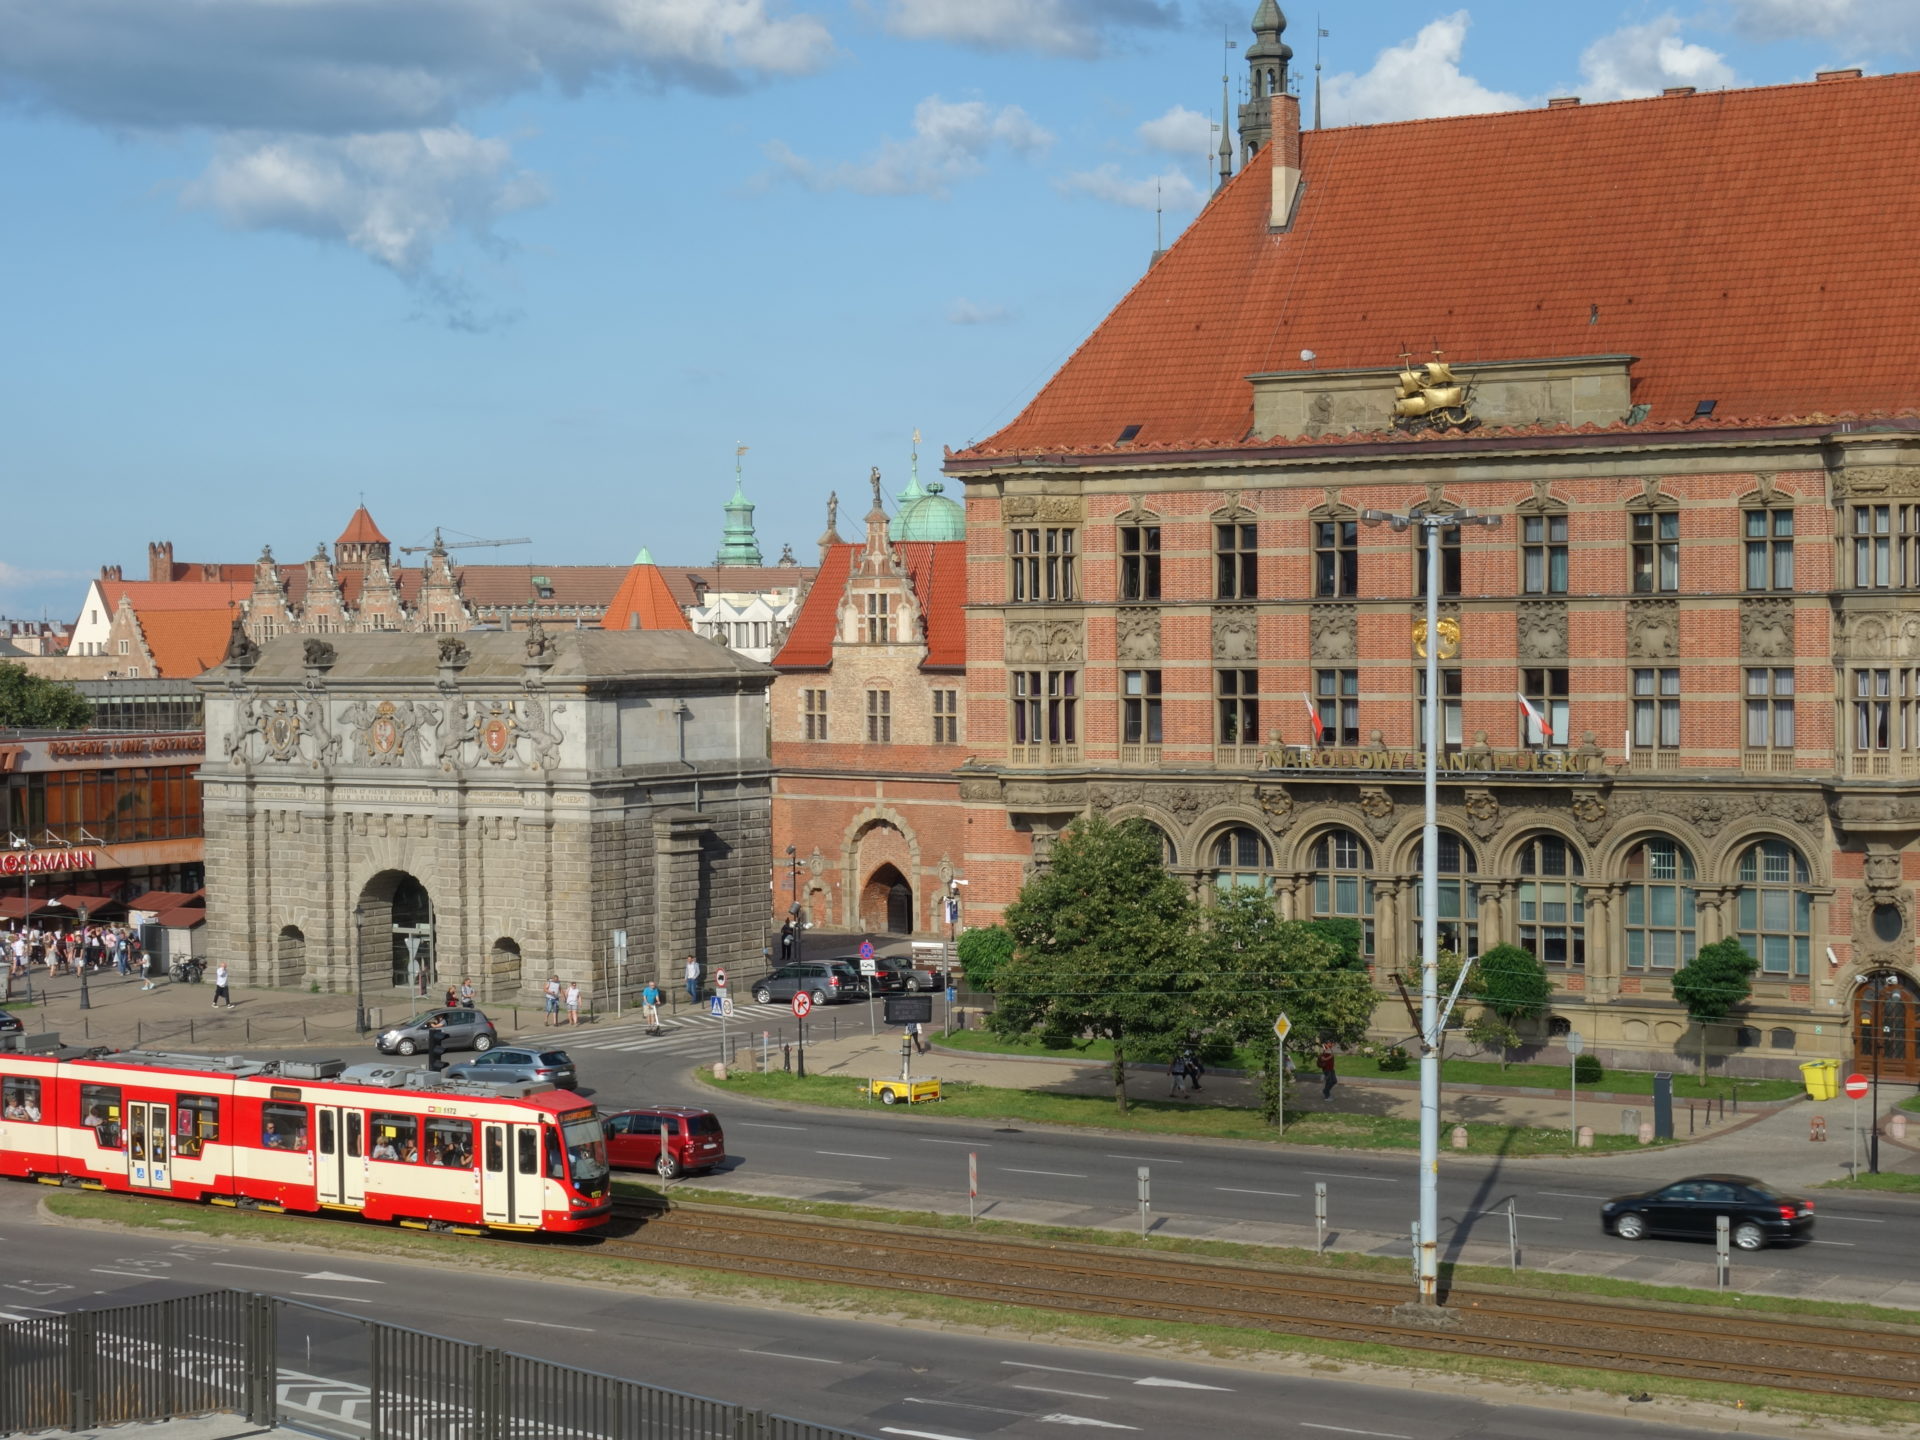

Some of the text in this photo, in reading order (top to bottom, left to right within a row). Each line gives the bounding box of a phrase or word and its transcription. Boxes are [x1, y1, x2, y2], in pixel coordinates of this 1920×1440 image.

[1265, 749, 1586, 773] NARODOWY BANK POLSKI
[0, 850, 95, 876] OSSMANN
